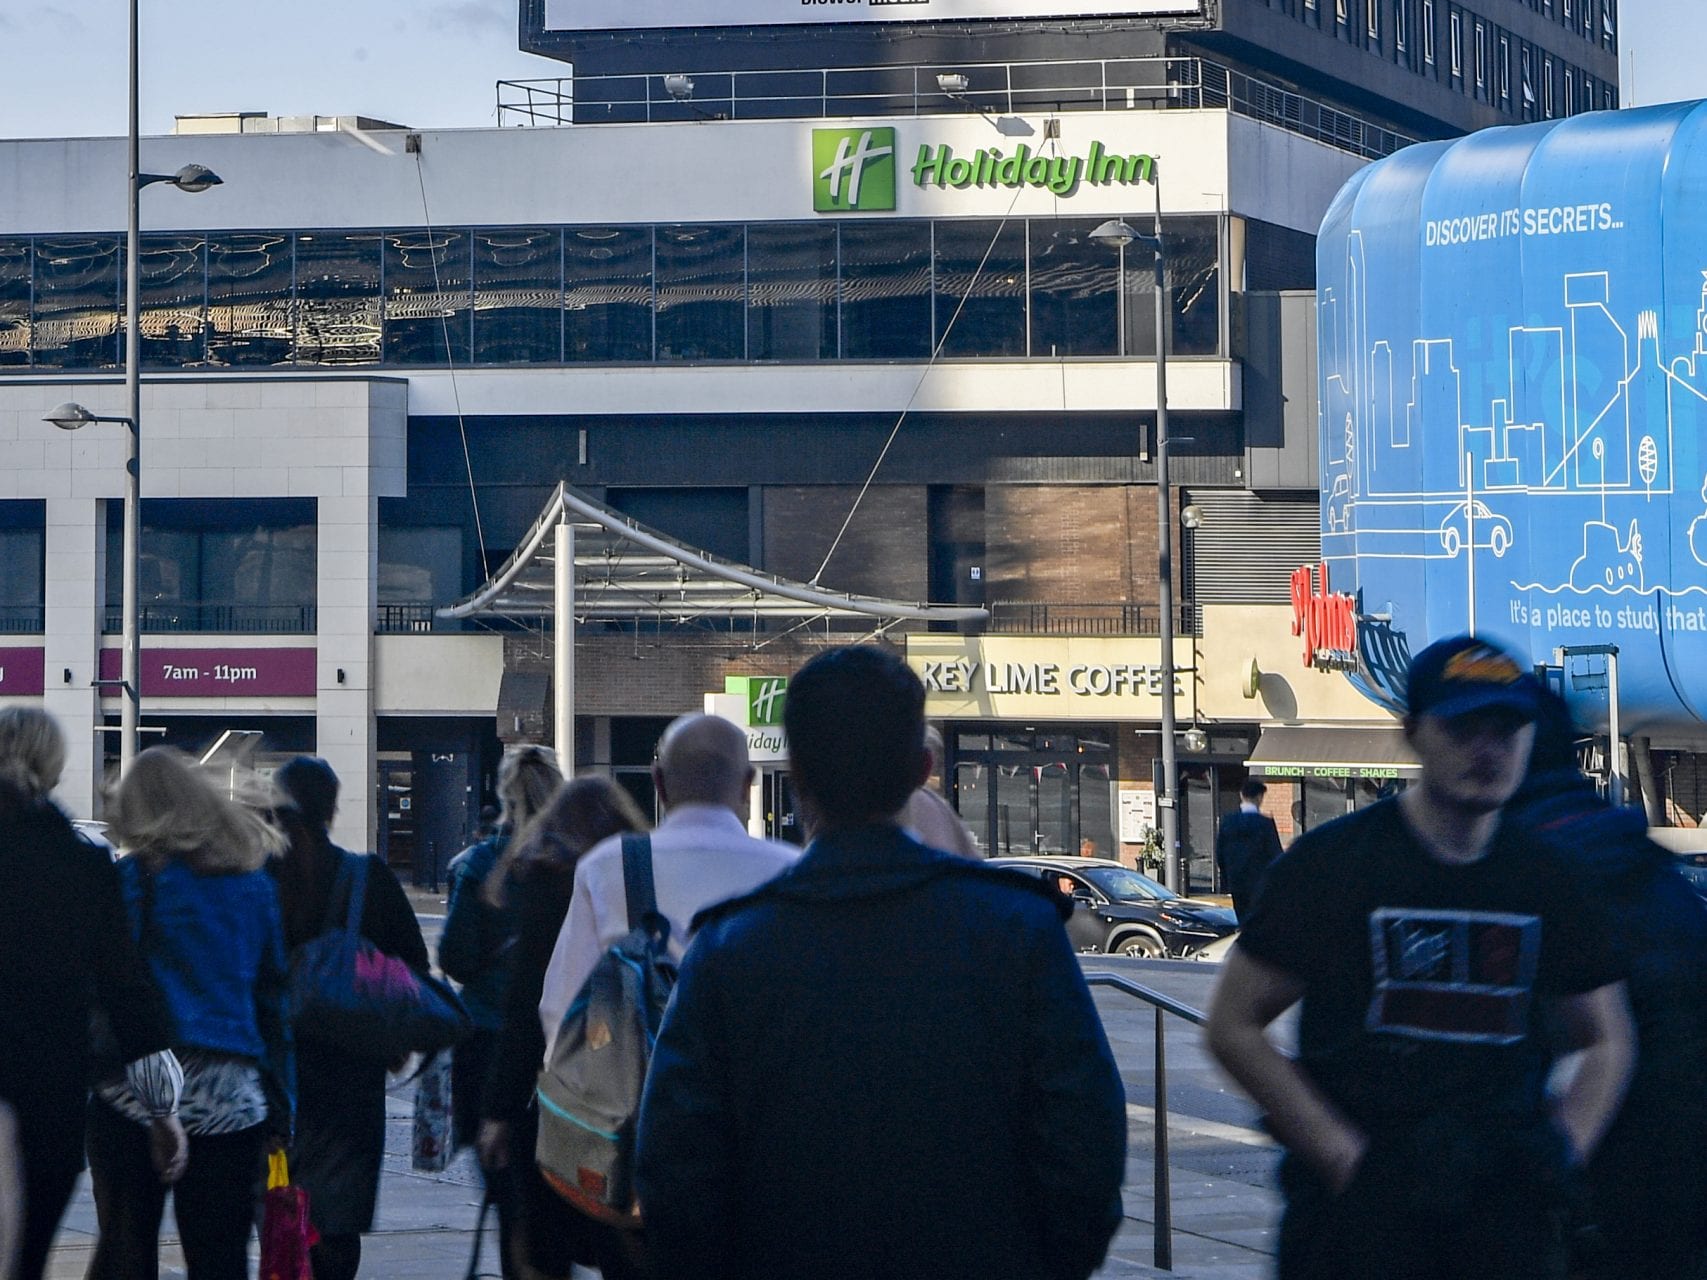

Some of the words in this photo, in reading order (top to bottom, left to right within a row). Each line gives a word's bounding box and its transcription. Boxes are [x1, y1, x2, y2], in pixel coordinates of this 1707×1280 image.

[911, 142, 1079, 195] Holiday
[1086, 140, 1154, 183] Inn
[1425, 212, 1497, 246] DISCOVER
[1500, 208, 1520, 237] ITS
[1523, 202, 1624, 235] SECRETS...
[1510, 599, 1528, 624] It's
[1531, 608, 1542, 627] a
[1547, 602, 1591, 631] place
[1594, 604, 1612, 628] to
[1617, 604, 1661, 636] study
[1666, 605, 1706, 632] that
[163, 665, 199, 680] 7am
[214, 665, 257, 683] 11pm
[922, 662, 980, 692] KEY
[984, 663, 1058, 693] LIME
[1264, 766, 1304, 776] BRUNCH
[1313, 767, 1350, 777] COFFEE
[1359, 768, 1398, 778] SHAKES
